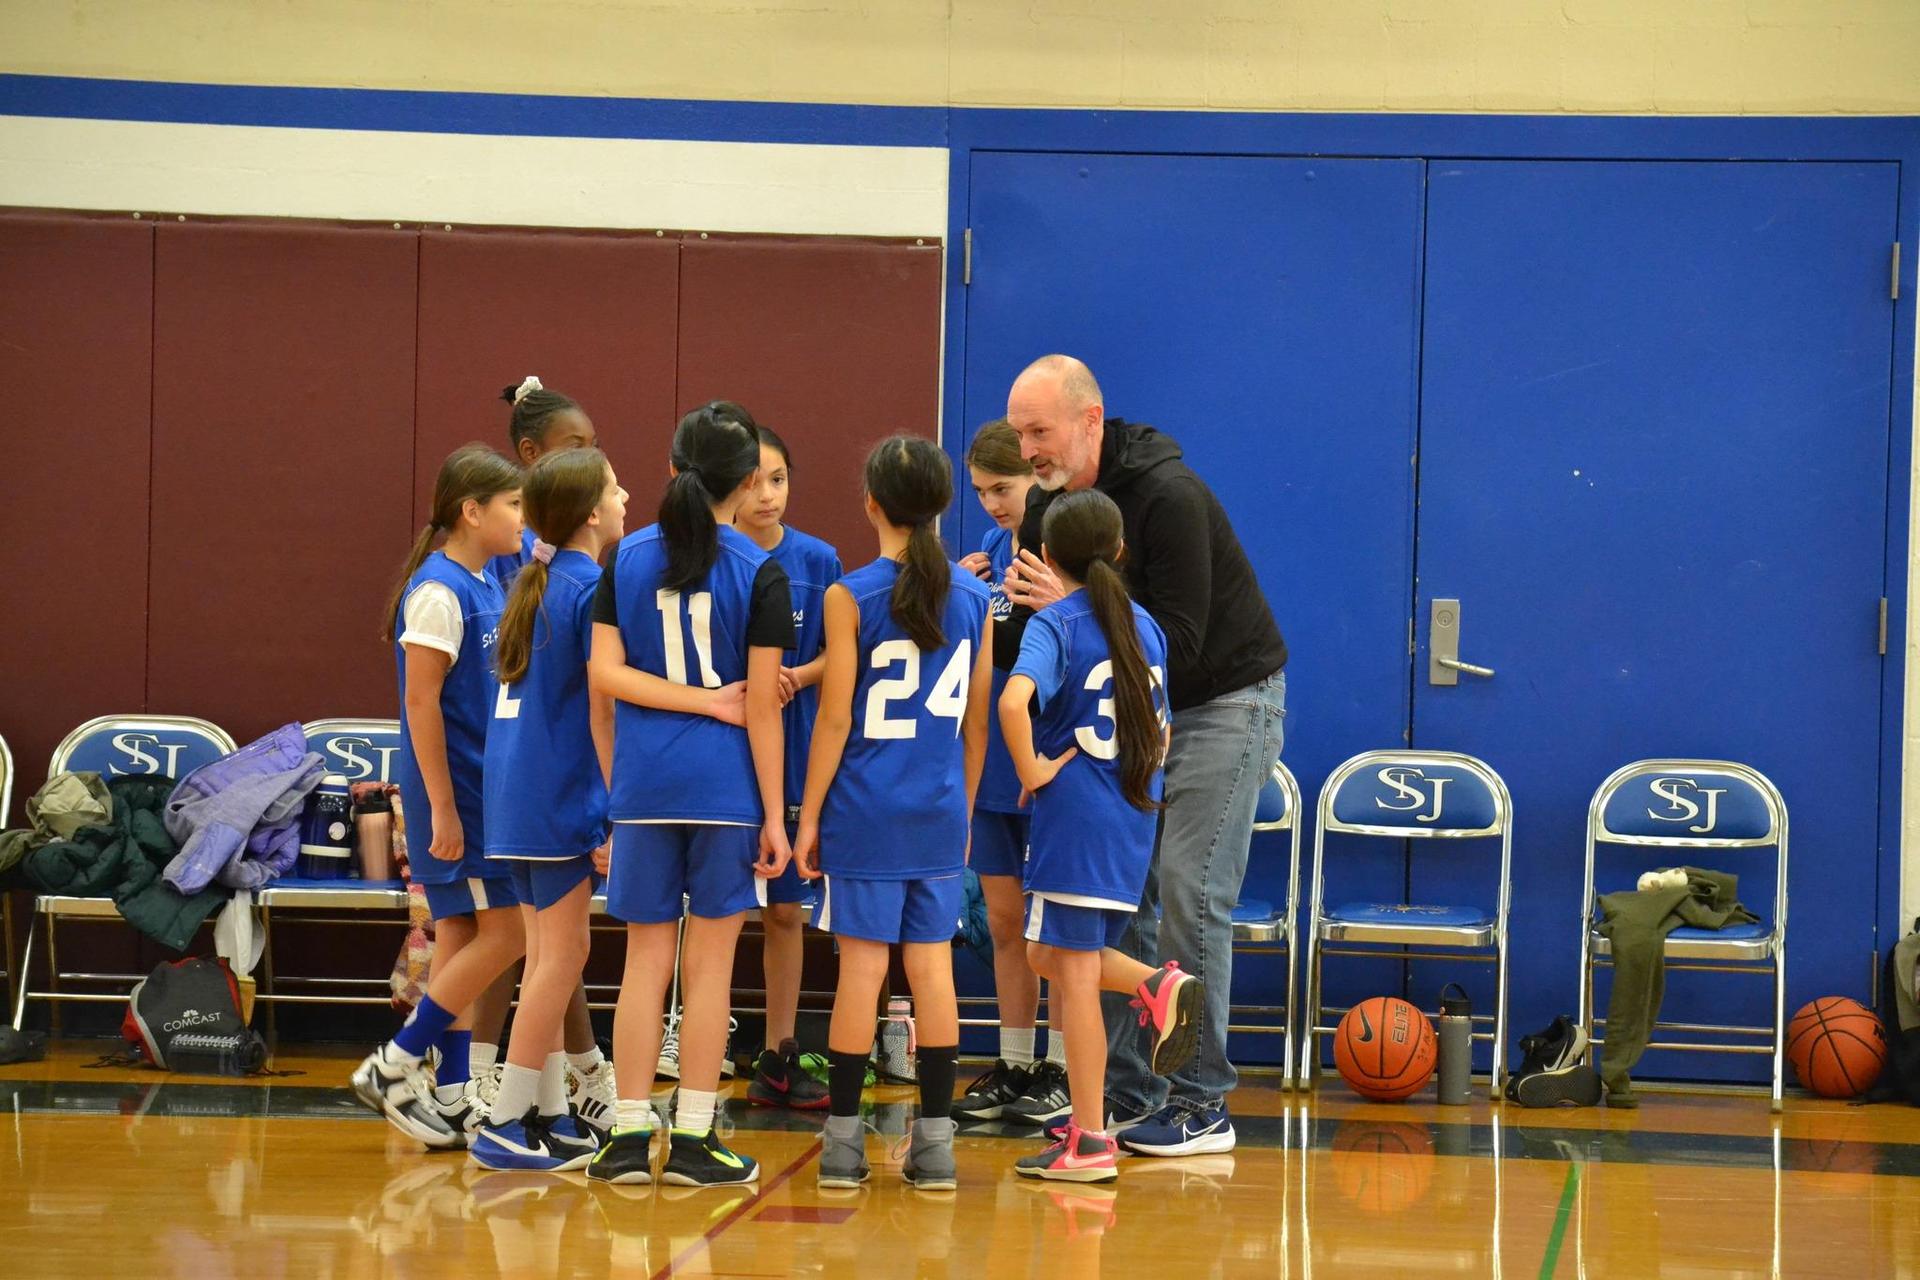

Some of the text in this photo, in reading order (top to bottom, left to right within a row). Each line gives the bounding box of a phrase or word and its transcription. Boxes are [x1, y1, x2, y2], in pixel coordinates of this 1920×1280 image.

[656, 588, 722, 688] 11
[863, 638, 971, 740] 24
[163, 1012, 221, 1032] COMCAST
[1391, 1003, 1408, 1045] ELITE
